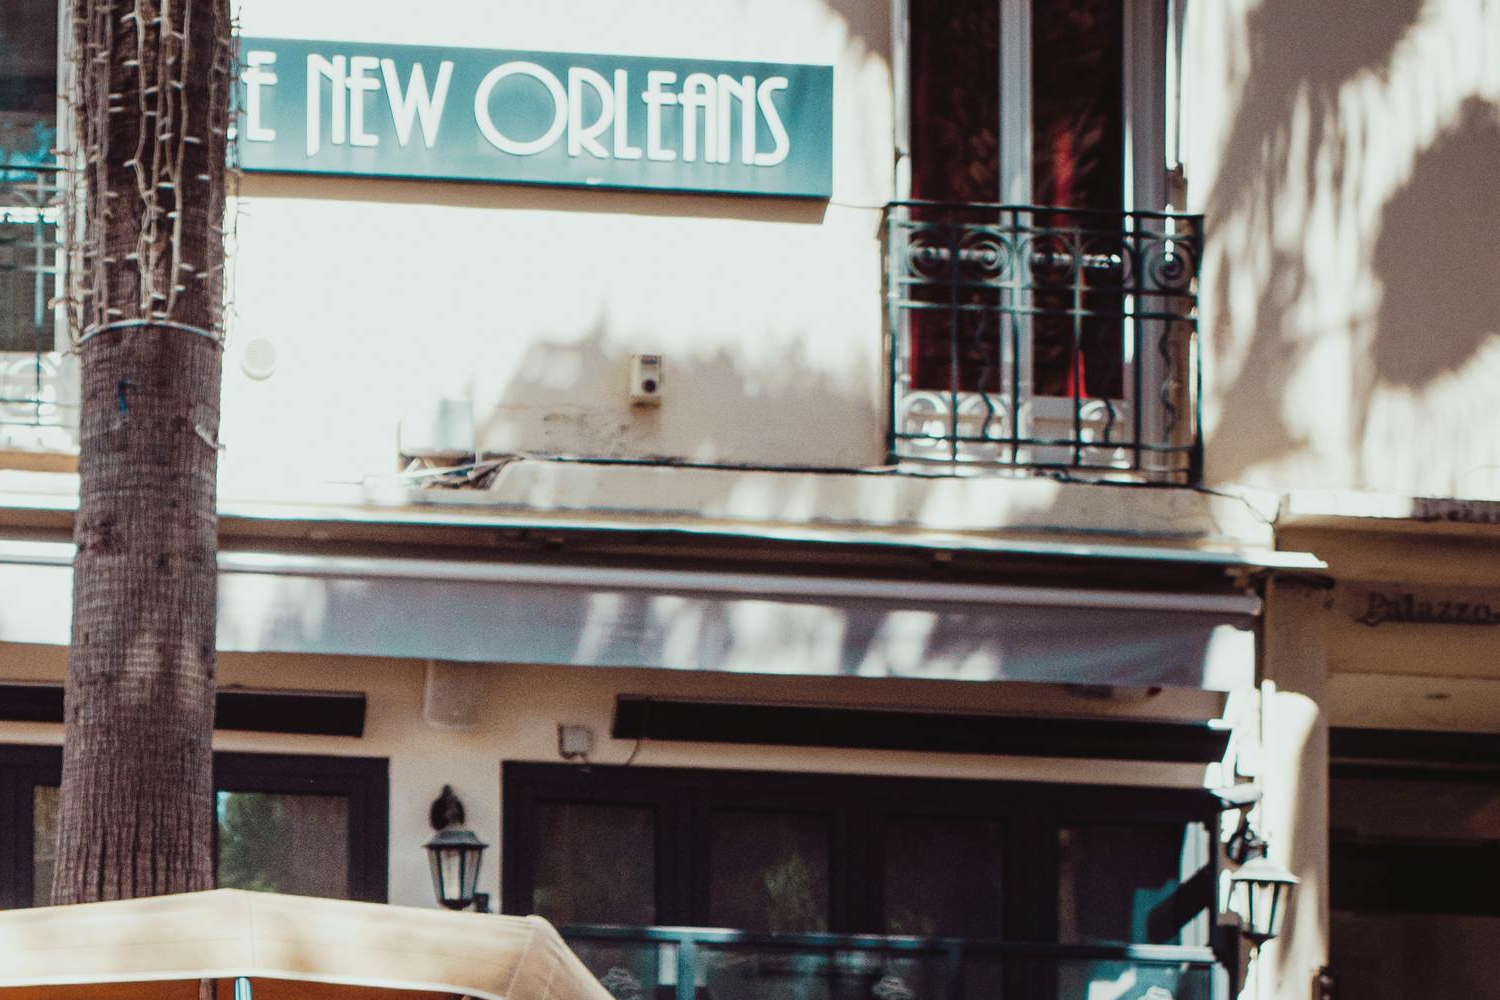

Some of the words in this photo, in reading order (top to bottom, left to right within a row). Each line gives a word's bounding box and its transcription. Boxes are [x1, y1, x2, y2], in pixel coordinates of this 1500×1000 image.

[242, 51, 277, 141] E
[306, 53, 455, 158] NEW
[474, 60, 791, 168] ORLEANS
